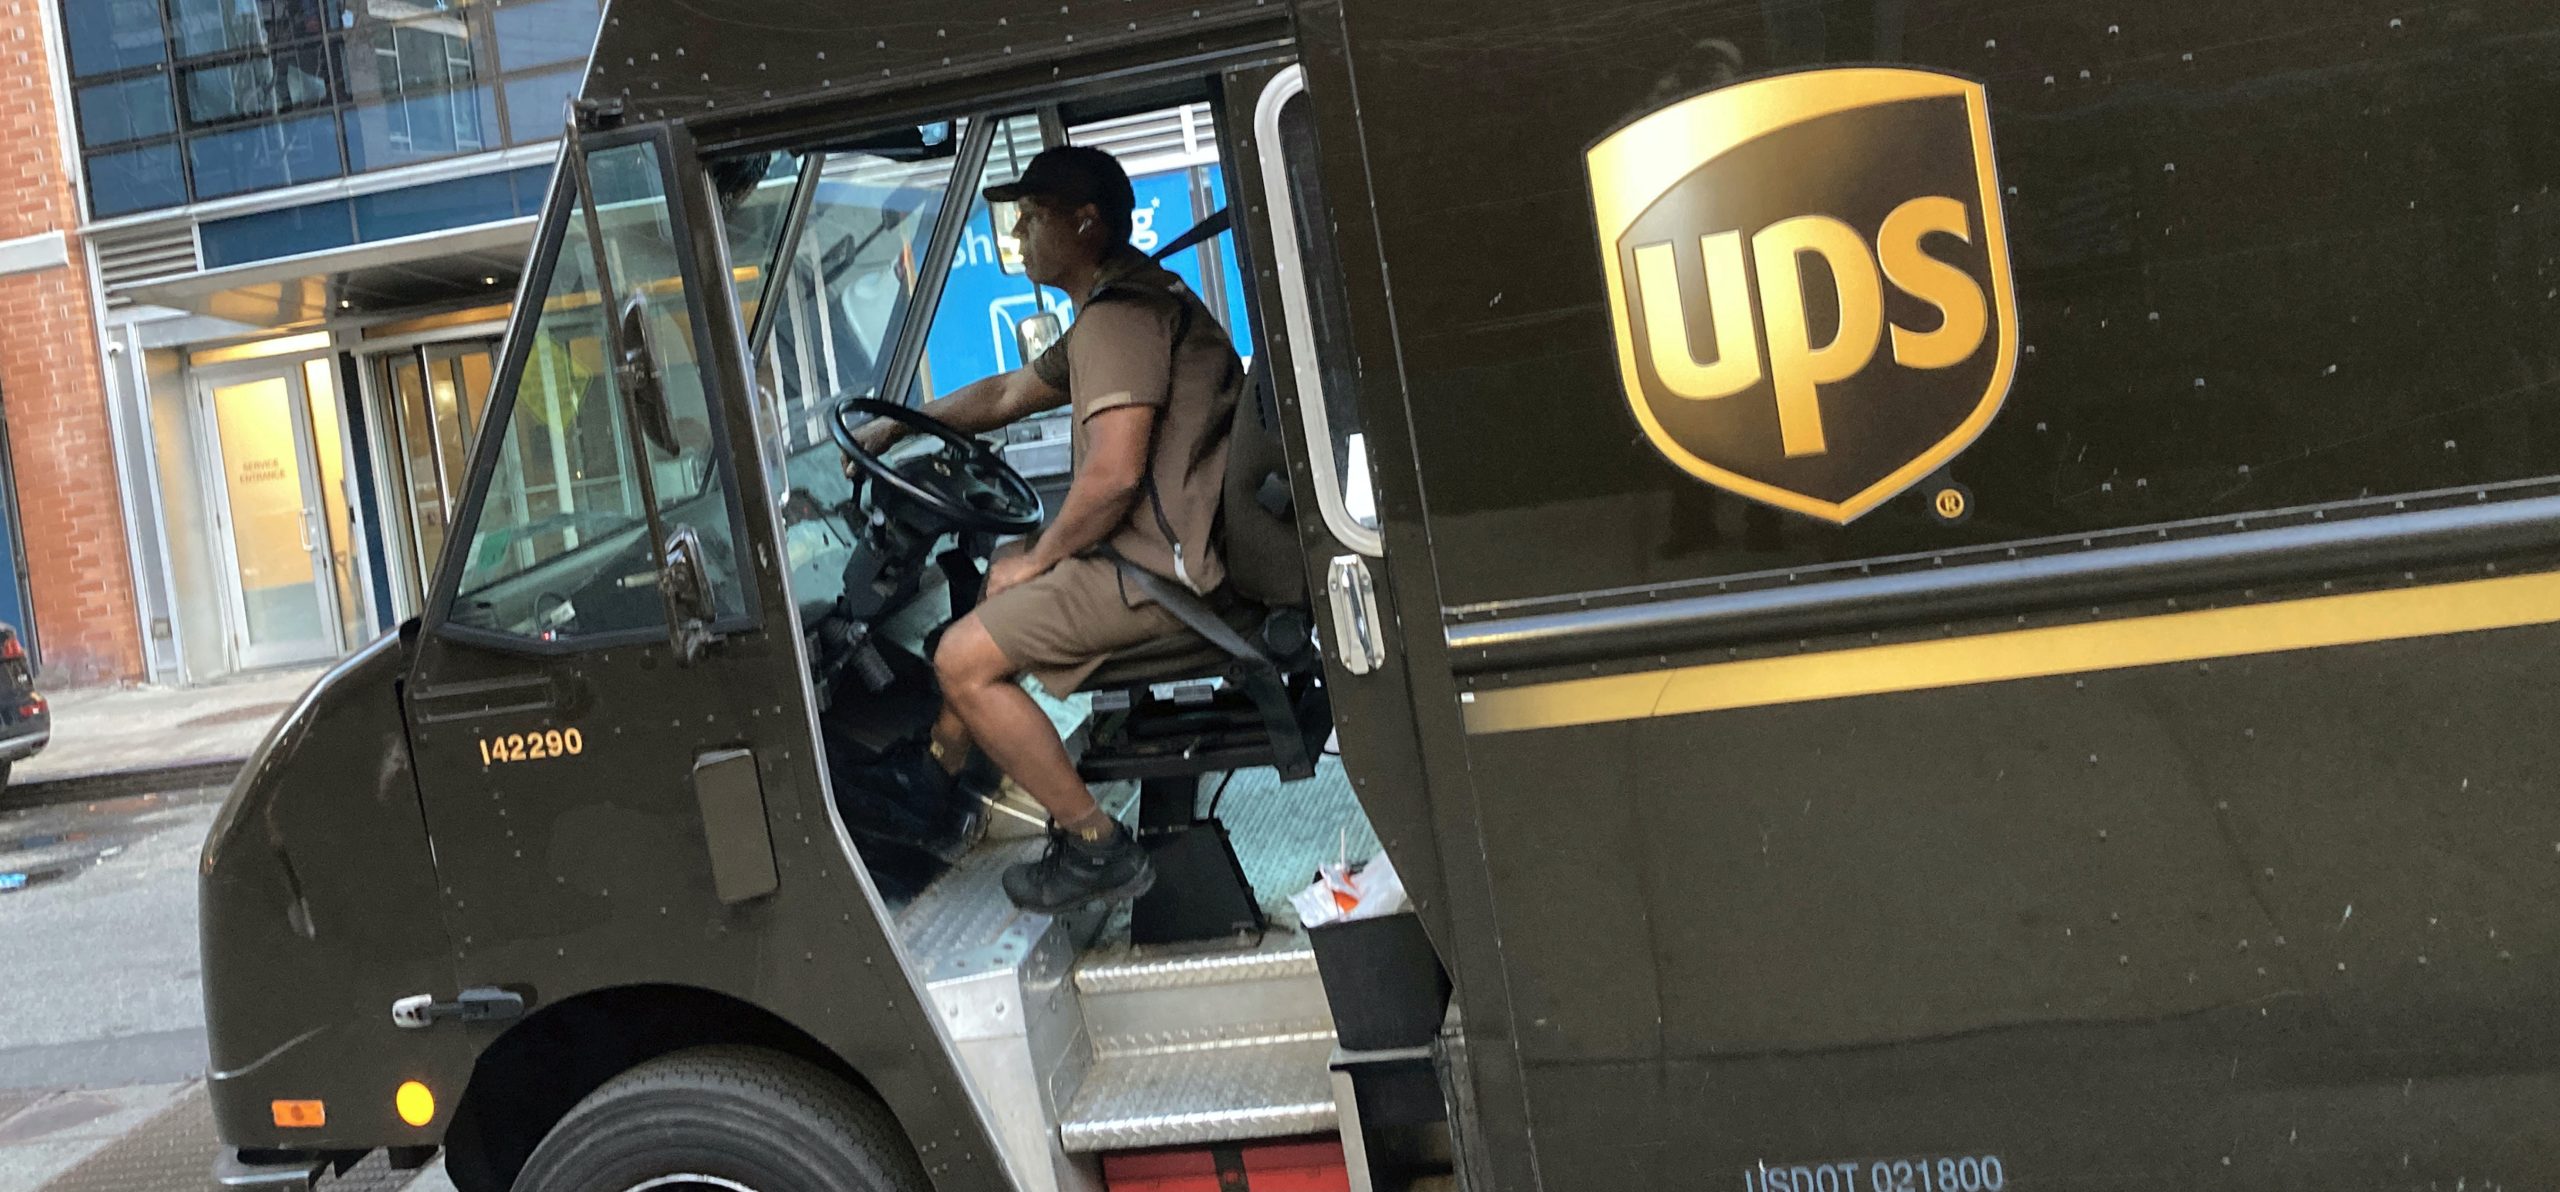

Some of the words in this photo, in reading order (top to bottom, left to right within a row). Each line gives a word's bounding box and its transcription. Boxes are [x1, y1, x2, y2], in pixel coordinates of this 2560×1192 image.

[1633, 195, 1988, 457] ups
[1745, 1158, 1859, 1192] USDOT
[1871, 1155, 2003, 1192] 021800
